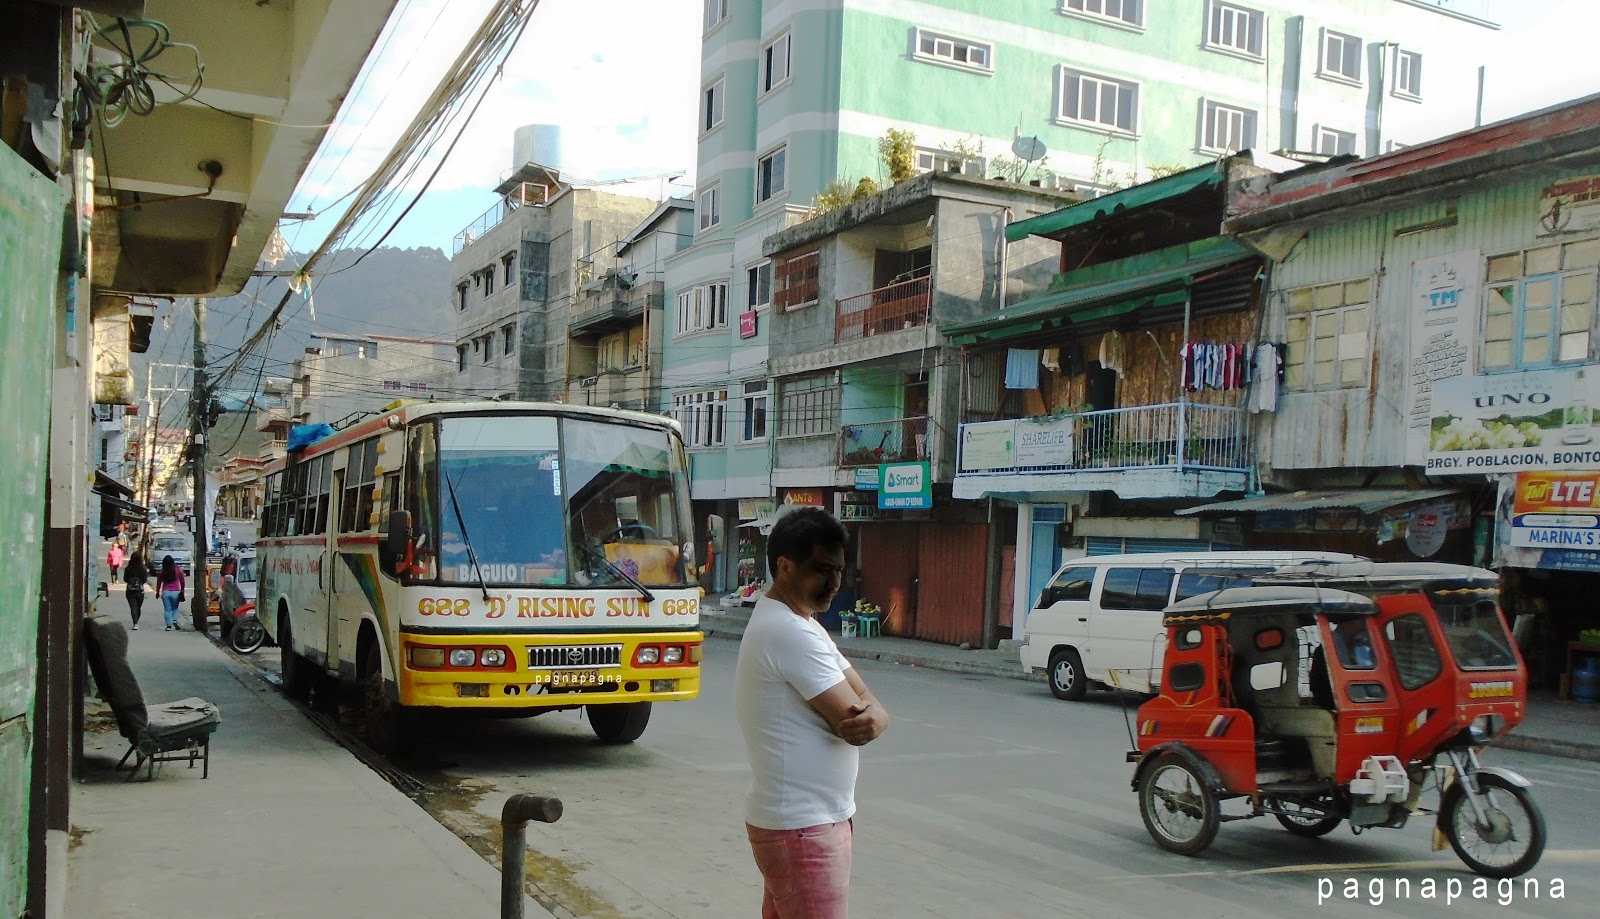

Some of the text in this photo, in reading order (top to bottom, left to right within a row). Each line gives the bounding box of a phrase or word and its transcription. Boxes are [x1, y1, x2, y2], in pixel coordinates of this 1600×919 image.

[1430, 290, 1456, 306] TM
[1473, 393, 1551, 407] UNO
[1021, 430, 1065, 446] SHARELIFE
[1427, 457, 1462, 469] BRGY.
[1466, 453, 1548, 466] POBLACION,
[895, 473, 919, 486] Smart
[1551, 480, 1595, 502] LTE
[1528, 530, 1594, 545] MARINA'S
[459, 564, 518, 582] BAGUIO
[418, 597, 471, 617] 688
[516, 596, 596, 618] RISING
[605, 597, 651, 618] SUN
[662, 598, 698, 616] 688
